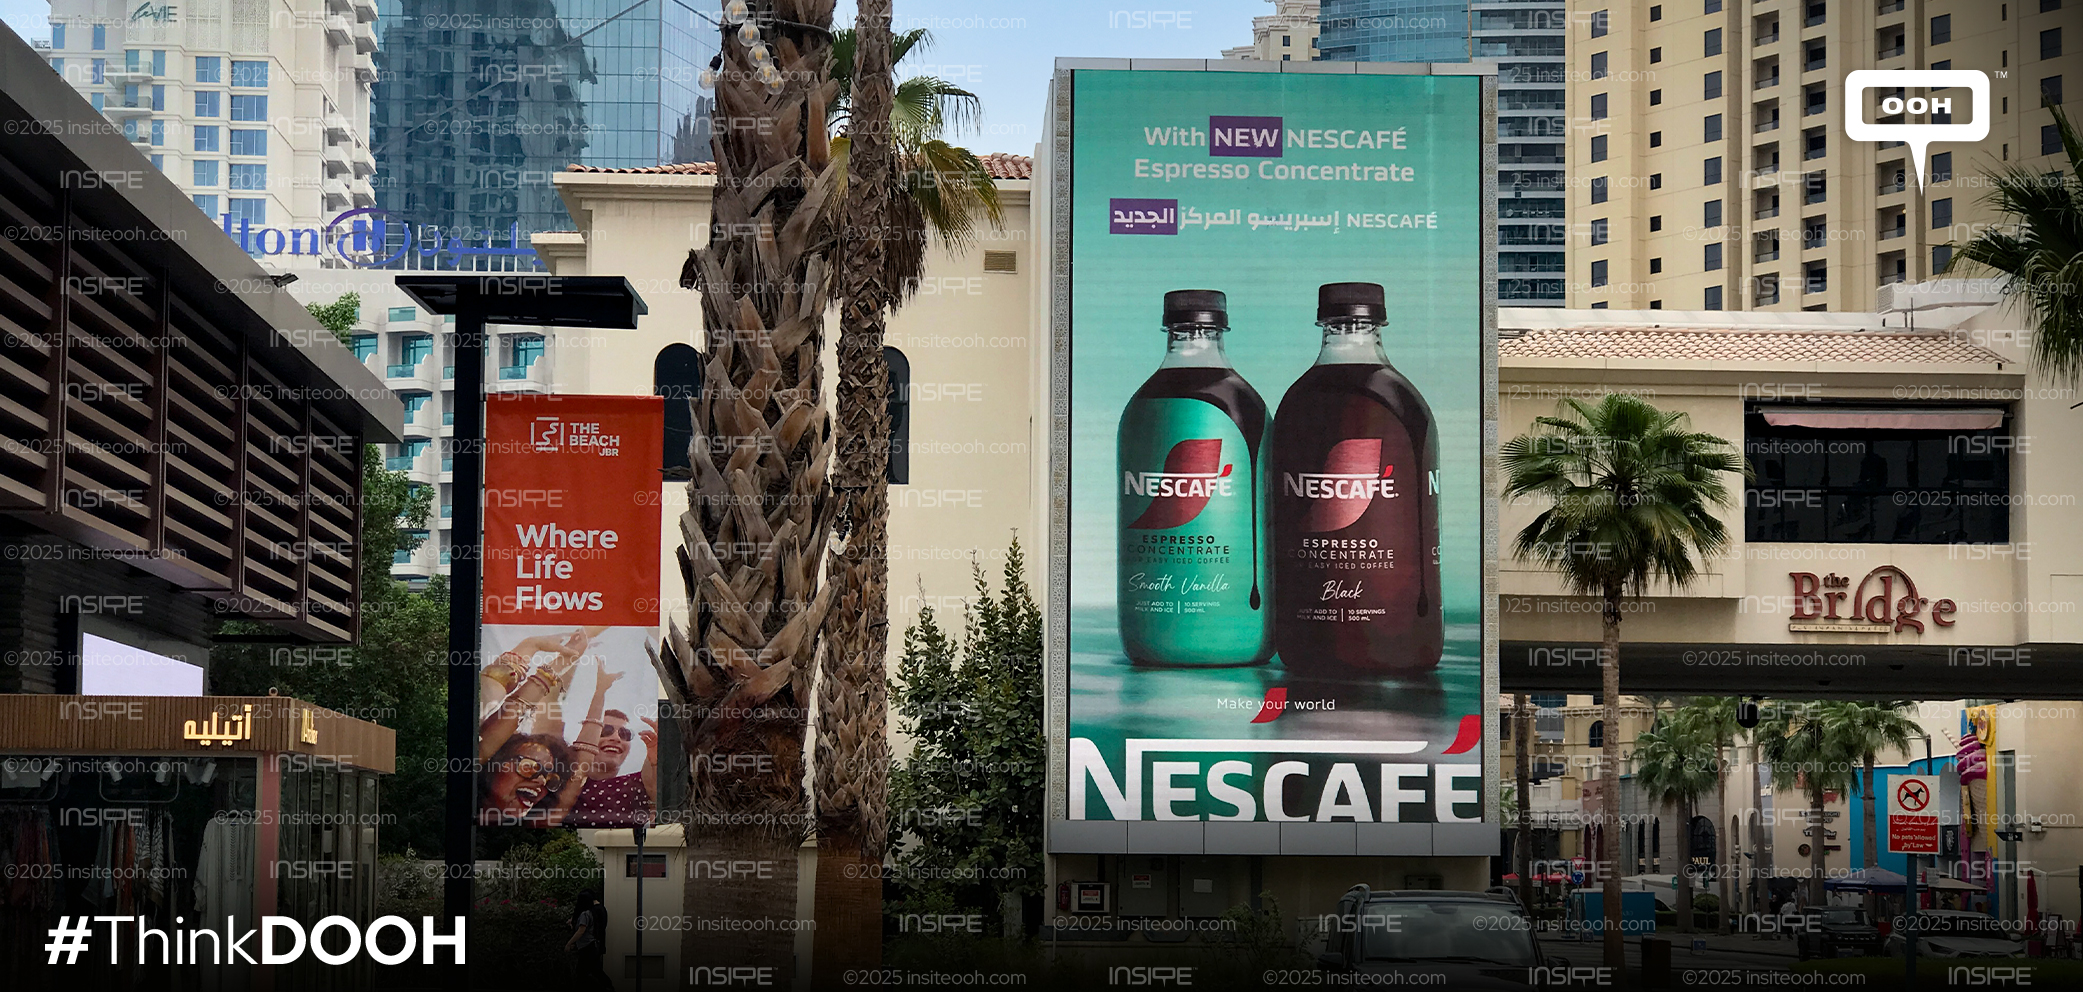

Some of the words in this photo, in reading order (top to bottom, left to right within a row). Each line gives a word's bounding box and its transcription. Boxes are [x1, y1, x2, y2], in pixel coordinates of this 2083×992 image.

[1144, 126, 1206, 146] With
[1214, 128, 1279, 148] NEW
[1287, 126, 1407, 150] NESCAFÉ
[1134, 158, 1250, 182] Espresso
[1258, 160, 1414, 182] Concentrate
[1113, 207, 1175, 229] الجديد
[1179, 206, 1242, 232] المركز
[1347, 212, 1438, 230] NESCAFÉ
[570, 422, 600, 434] THE
[569, 435, 620, 447] BEACH
[599, 448, 619, 457] JBR
[515, 523, 619, 549] Where
[1142, 535, 1215, 545] ESPRESSO
[1303, 538, 1379, 549] ESPRESSO
[1127, 545, 1230, 555] CONCENTRATE
[1288, 549, 1395, 560] CONCENTRATE
[516, 554, 574, 580] Life
[1173, 556, 1193, 564] ICED
[1197, 556, 1230, 565] COFFEE
[1335, 562, 1356, 570] ICED
[1360, 562, 1394, 570] COFFEE
[1128, 572, 1176, 592] Smooth
[1181, 572, 1230, 595] Vanilla
[1823, 572, 1850, 589] the
[515, 585, 604, 611] Flows
[1319, 579, 1364, 602] Black
[1217, 697, 1253, 710] Make
[1257, 699, 1290, 713] your
[1294, 698, 1336, 711] world
[183, 704, 252, 747] أتيليه
